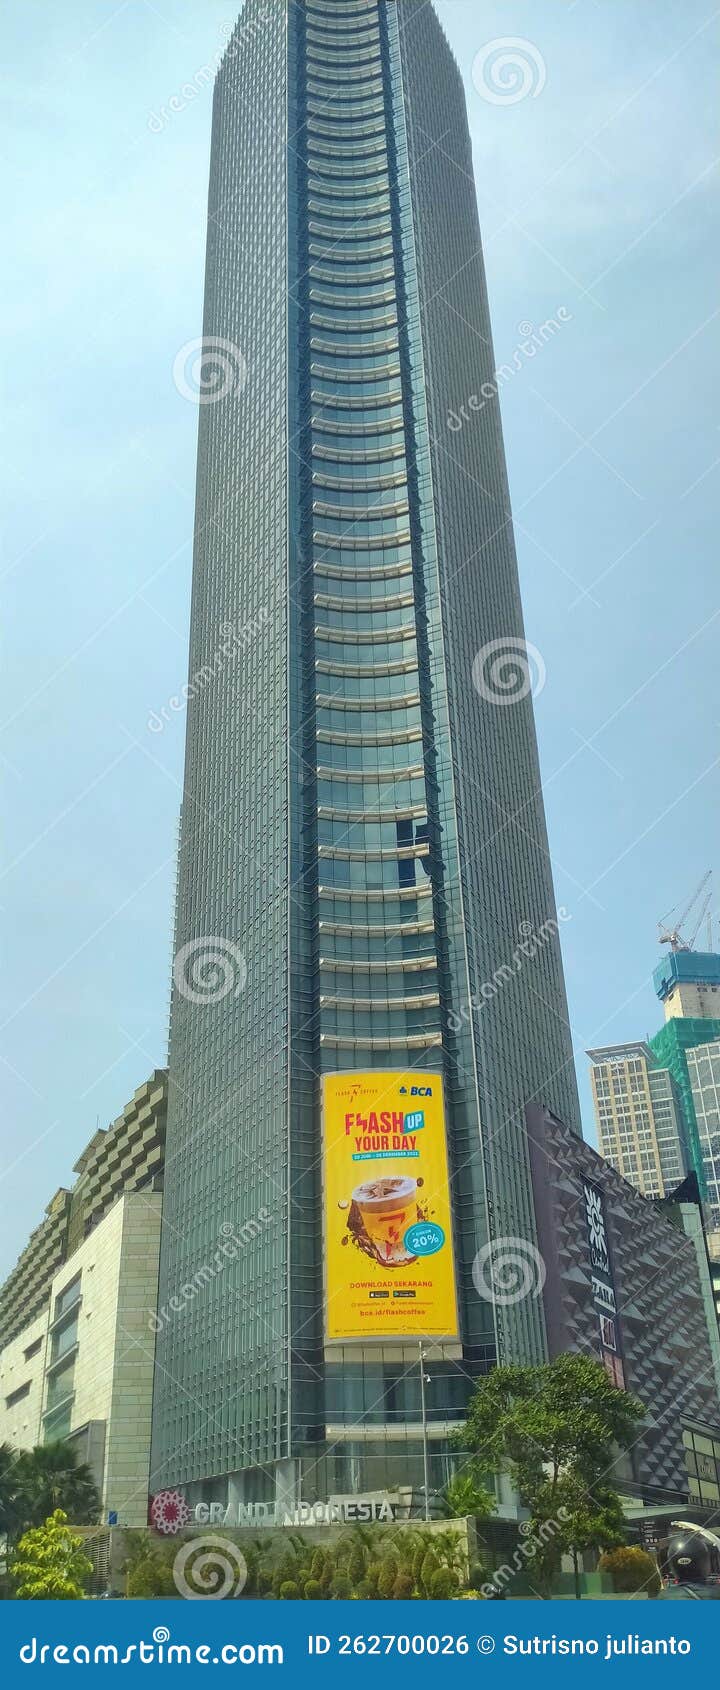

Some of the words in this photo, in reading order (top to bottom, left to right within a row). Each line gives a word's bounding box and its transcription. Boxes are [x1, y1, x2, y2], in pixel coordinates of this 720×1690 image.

[410, 1086, 432, 1097] BCA
[407, 1113, 422, 1129] UP
[355, 1136, 389, 1151] YOUR
[392, 1135, 417, 1150] DAY
[412, 1233, 439, 1248] 20%
[350, 1281, 392, 1289] DOWNLOAD
[394, 1280, 433, 1288] SEKARANG
[195, 1502, 269, 1523] GRAND
[275, 1500, 395, 1524] INDONESIA
